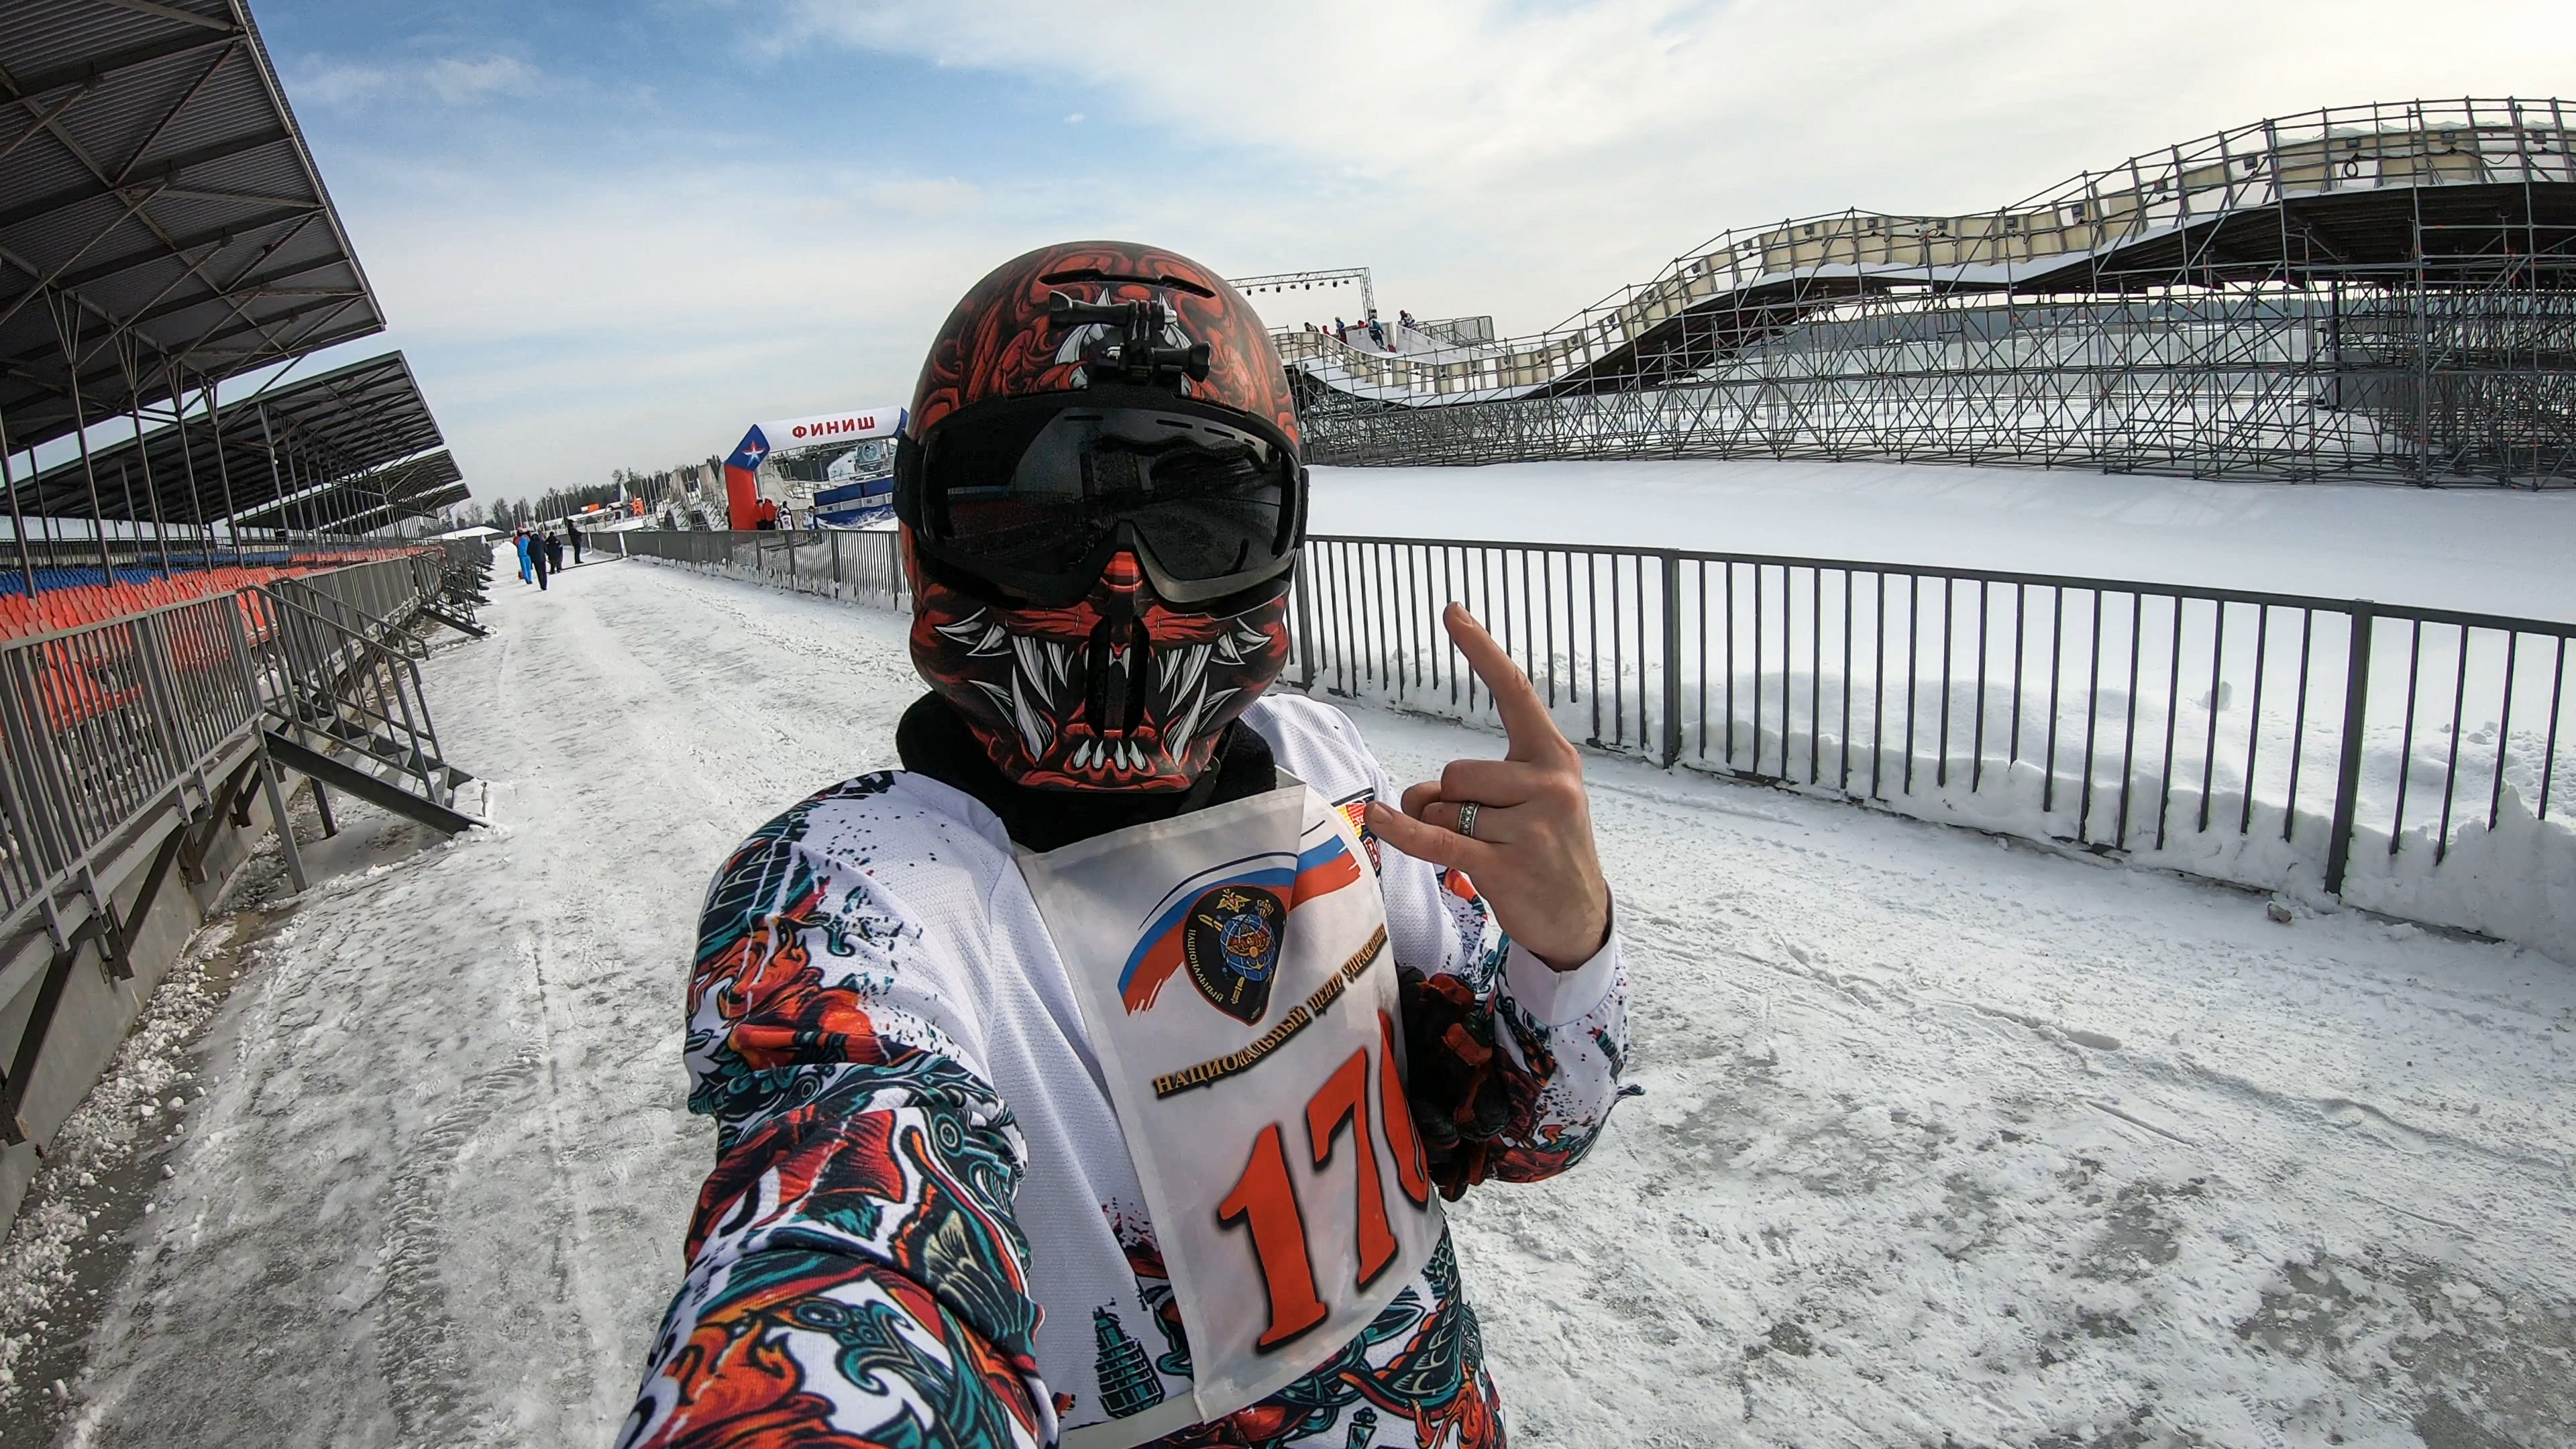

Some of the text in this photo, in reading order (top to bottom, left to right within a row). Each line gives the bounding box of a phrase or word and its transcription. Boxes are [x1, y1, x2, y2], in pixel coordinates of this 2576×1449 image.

[792, 416, 875, 438] ФИНИШ
[1187, 928, 1224, 1003] НАЦИОНАЛЬНЫЙ
[1155, 1006, 1309, 1095] НАЦИОНАЛЬНЫЙ
[1307, 973, 1344, 1012] ЦЕНТР
